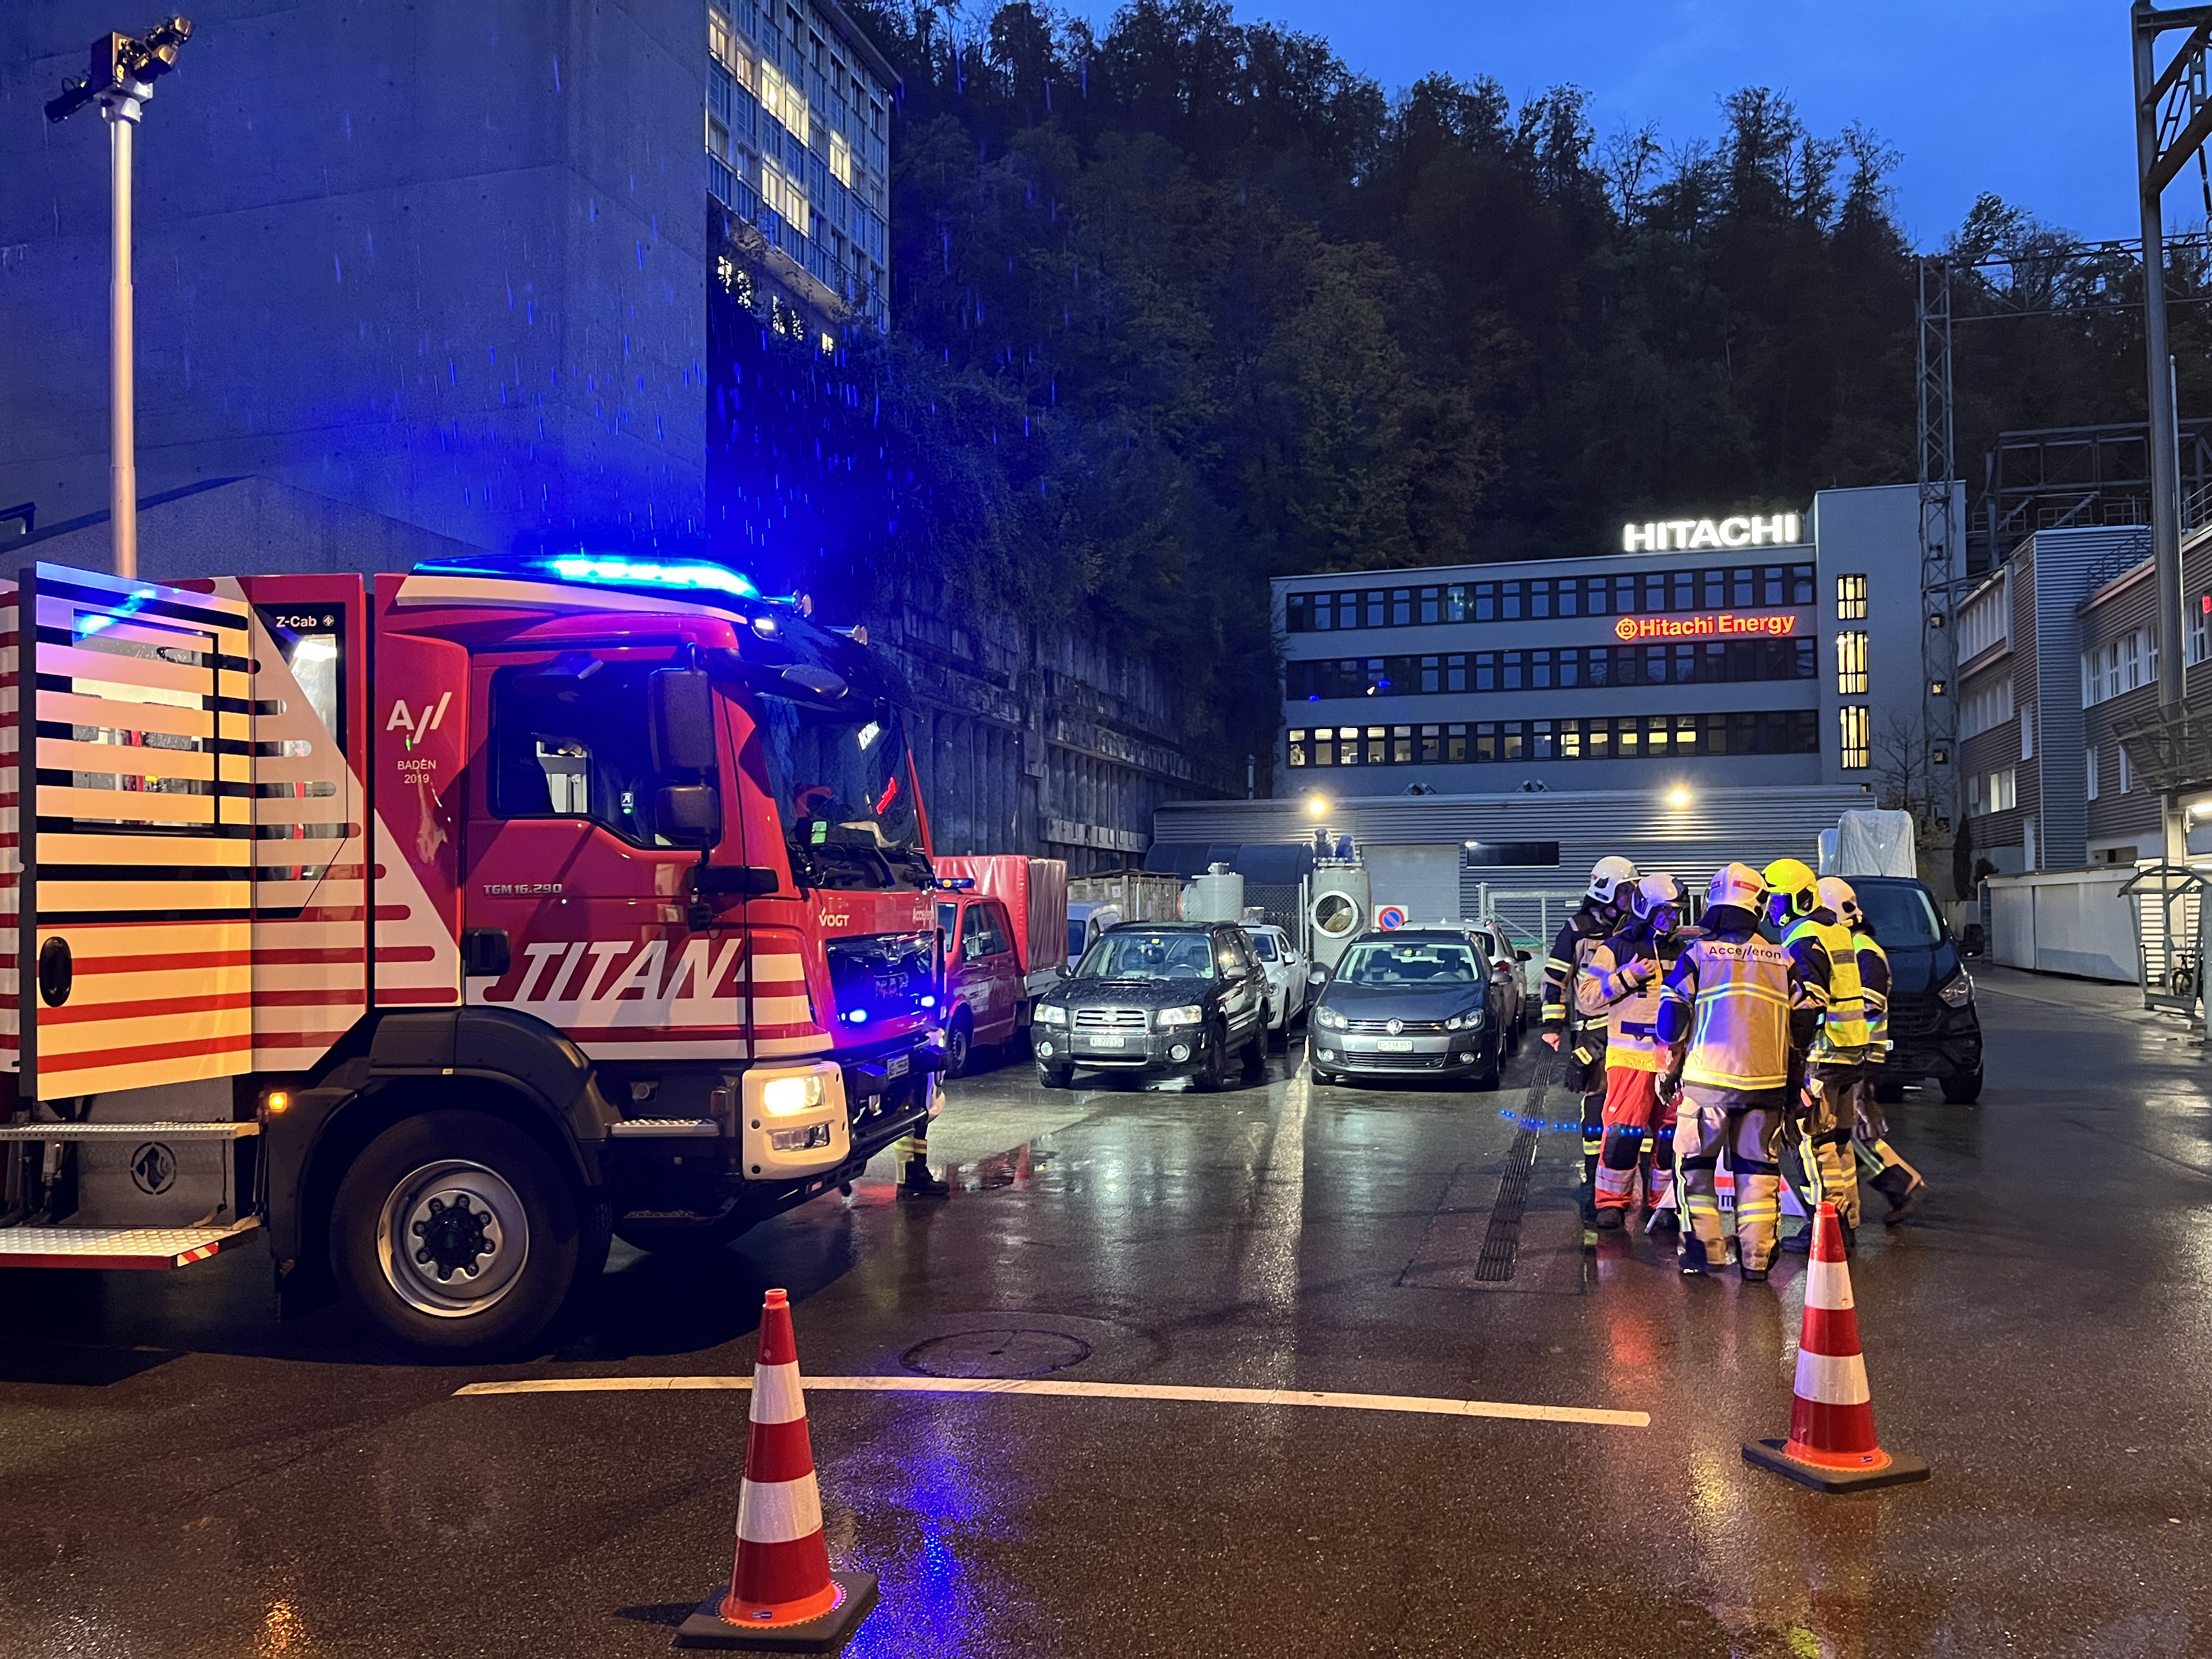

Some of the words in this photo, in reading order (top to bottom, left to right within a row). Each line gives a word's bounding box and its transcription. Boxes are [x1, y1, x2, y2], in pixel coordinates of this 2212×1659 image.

[1623, 514, 1795, 551] HITACHI
[276, 616, 317, 627] Z-Cab
[1639, 616, 1714, 637] Hitachi
[1717, 614, 1795, 635] Energy
[397, 760, 436, 770] BADEN
[404, 774, 430, 783] 2019
[483, 884, 512, 895] TGM
[514, 884, 562, 894] 16.290
[819, 906, 850, 927] VOGT
[512, 938, 742, 1002] TITAN
